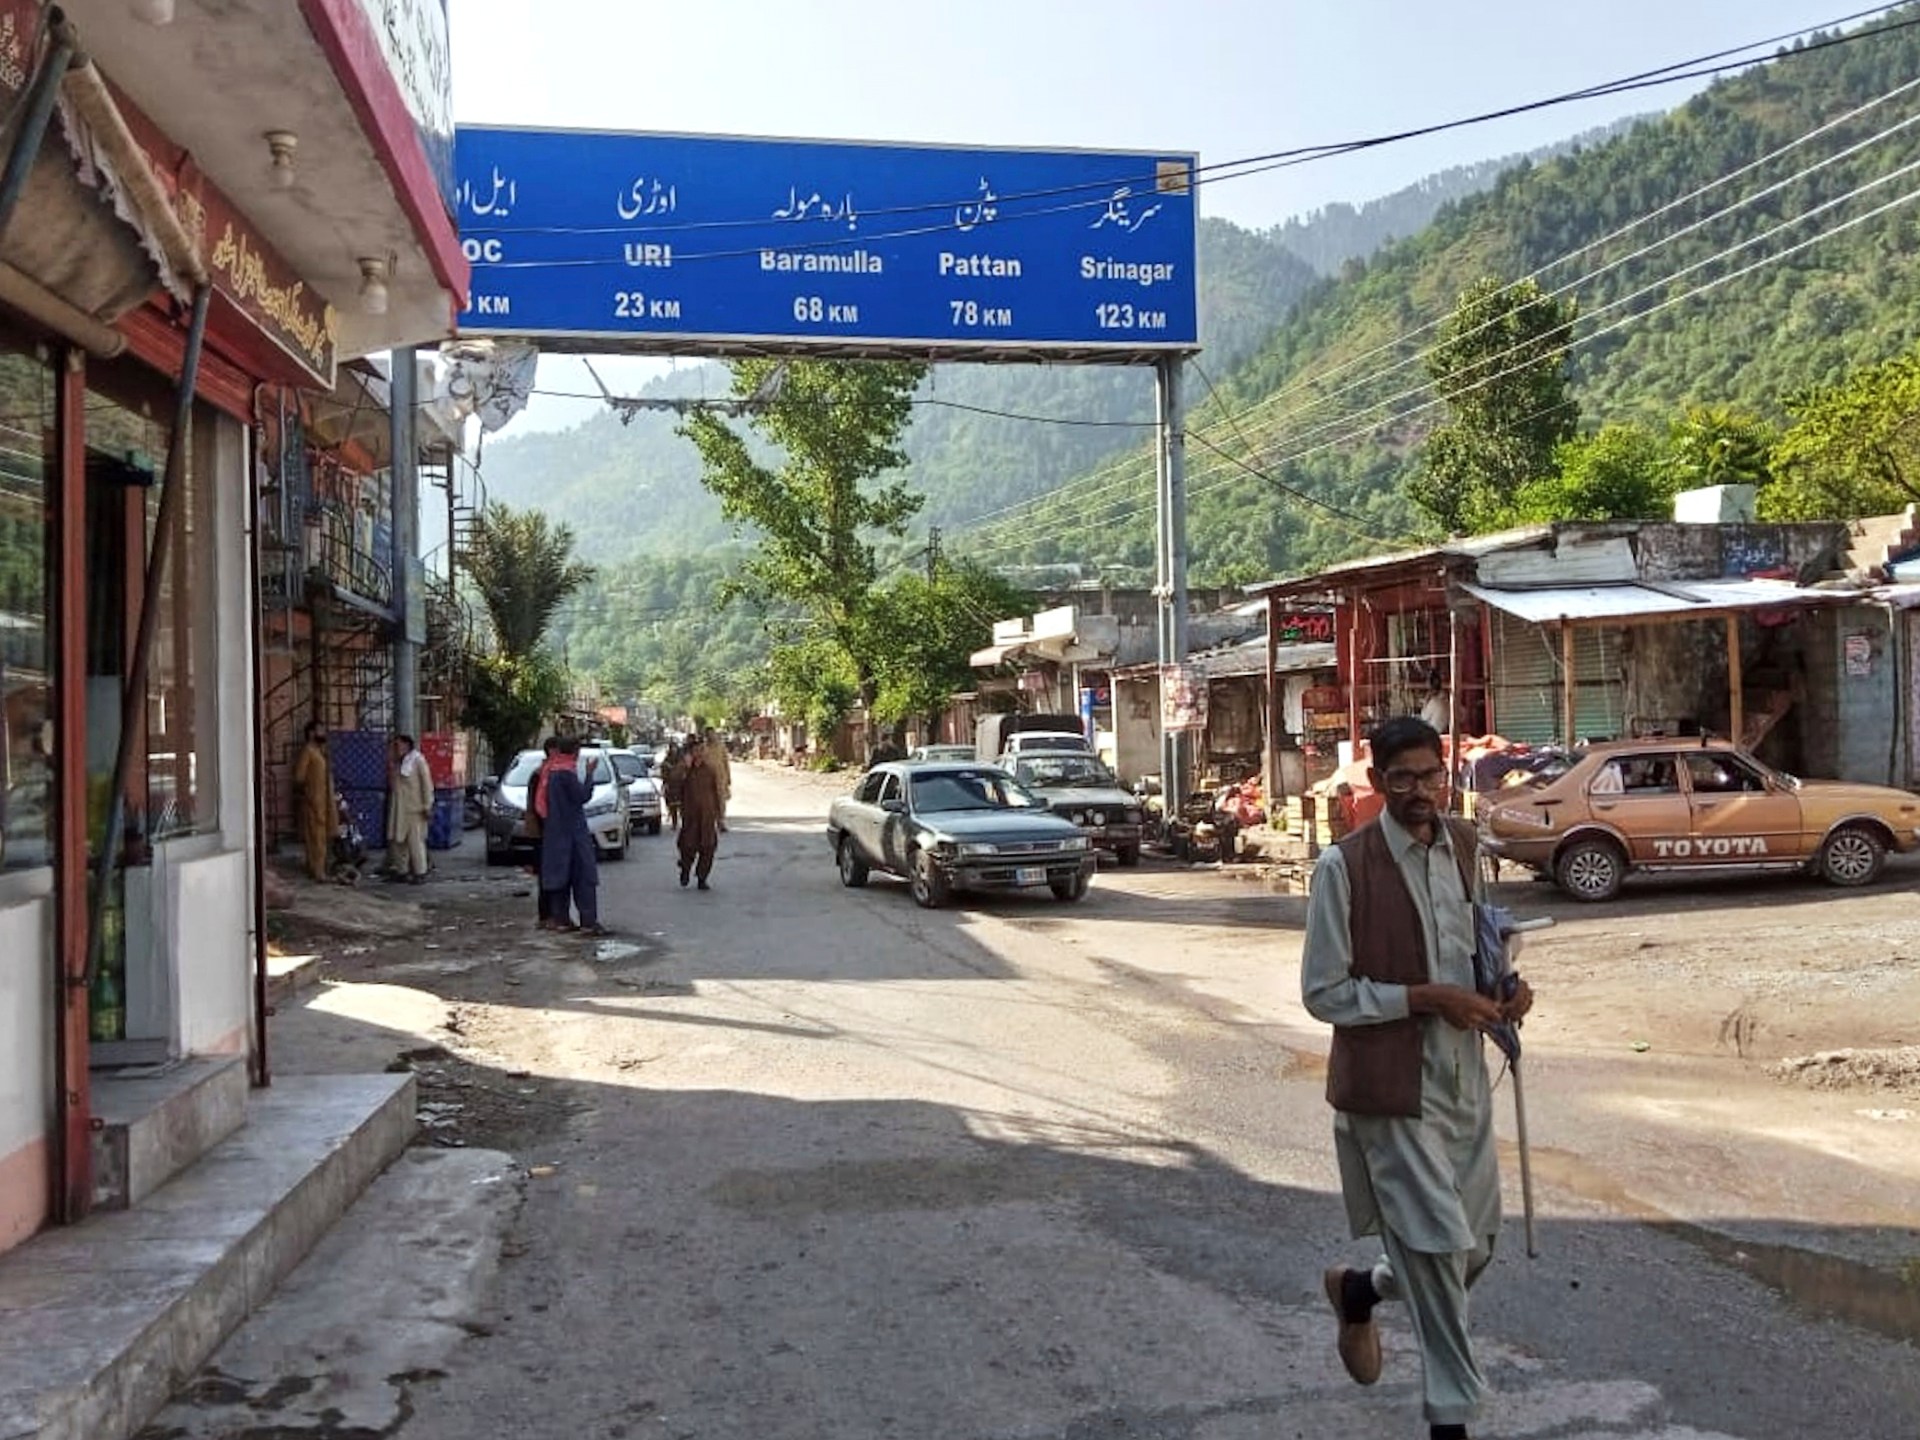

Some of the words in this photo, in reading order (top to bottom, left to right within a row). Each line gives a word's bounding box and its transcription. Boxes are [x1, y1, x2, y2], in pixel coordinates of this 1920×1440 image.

[617, 177, 676, 220] اوڑی
[461, 238, 503, 262] OC
[624, 243, 672, 268] URI
[760, 250, 883, 274] Baramulla
[939, 252, 1022, 277] Pattan
[1081, 256, 1175, 286] Srinagar
[478, 295, 510, 314] KM
[614, 292, 645, 318] 23
[650, 299, 681, 319] KM
[793, 296, 824, 322] 68
[828, 304, 859, 323] KM
[950, 301, 978, 326] 78
[983, 308, 1012, 326] KM
[1095, 304, 1134, 328] 123
[1138, 311, 1167, 329] KM
[1653, 836, 1768, 857] TOYOTA
